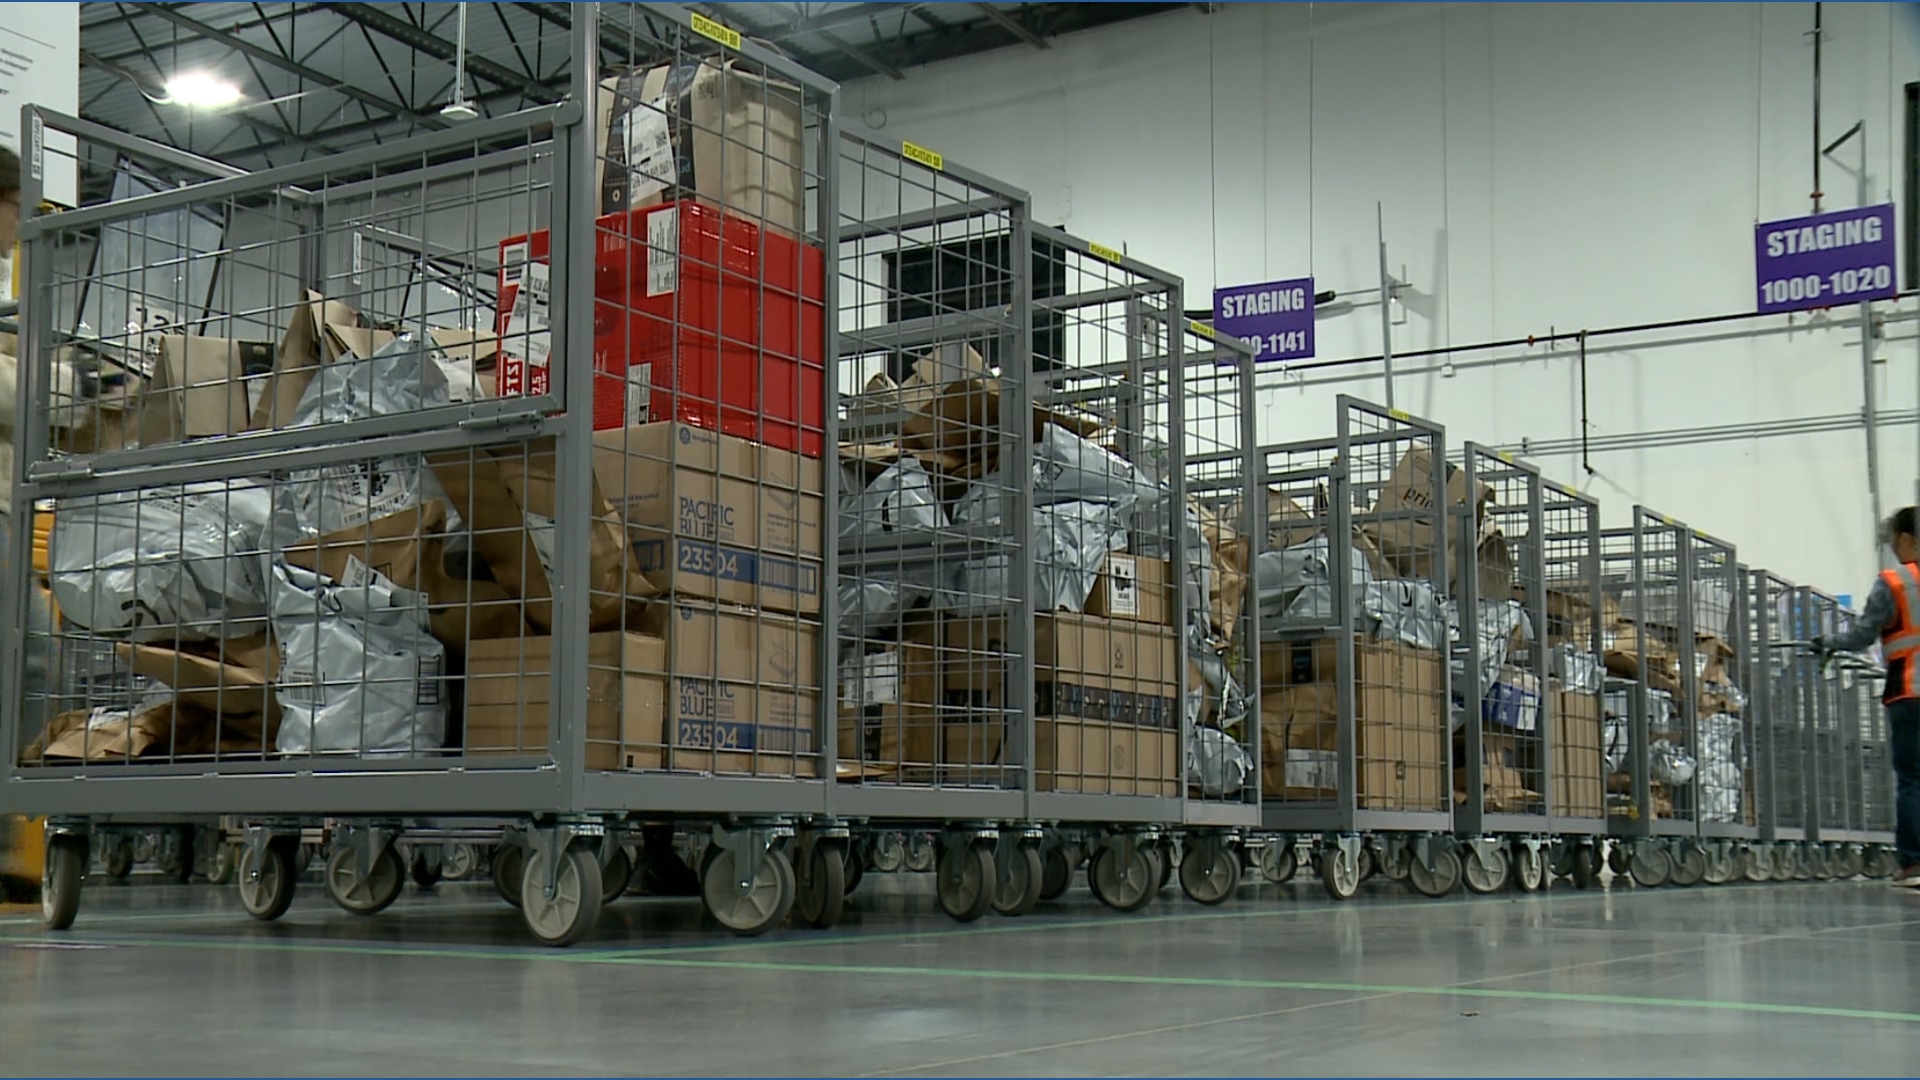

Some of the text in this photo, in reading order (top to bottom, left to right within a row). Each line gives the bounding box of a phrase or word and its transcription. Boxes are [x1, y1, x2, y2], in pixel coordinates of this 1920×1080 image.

[1766, 216, 1883, 257] STAGING
[1761, 265, 1891, 304] 1000-1020
[1222, 288, 1305, 318] STAGING
[679, 496, 735, 526] PACIFIC
[680, 545, 738, 577] 23504
[680, 695, 715, 718] BLUE
[681, 722, 739, 750] 23504
